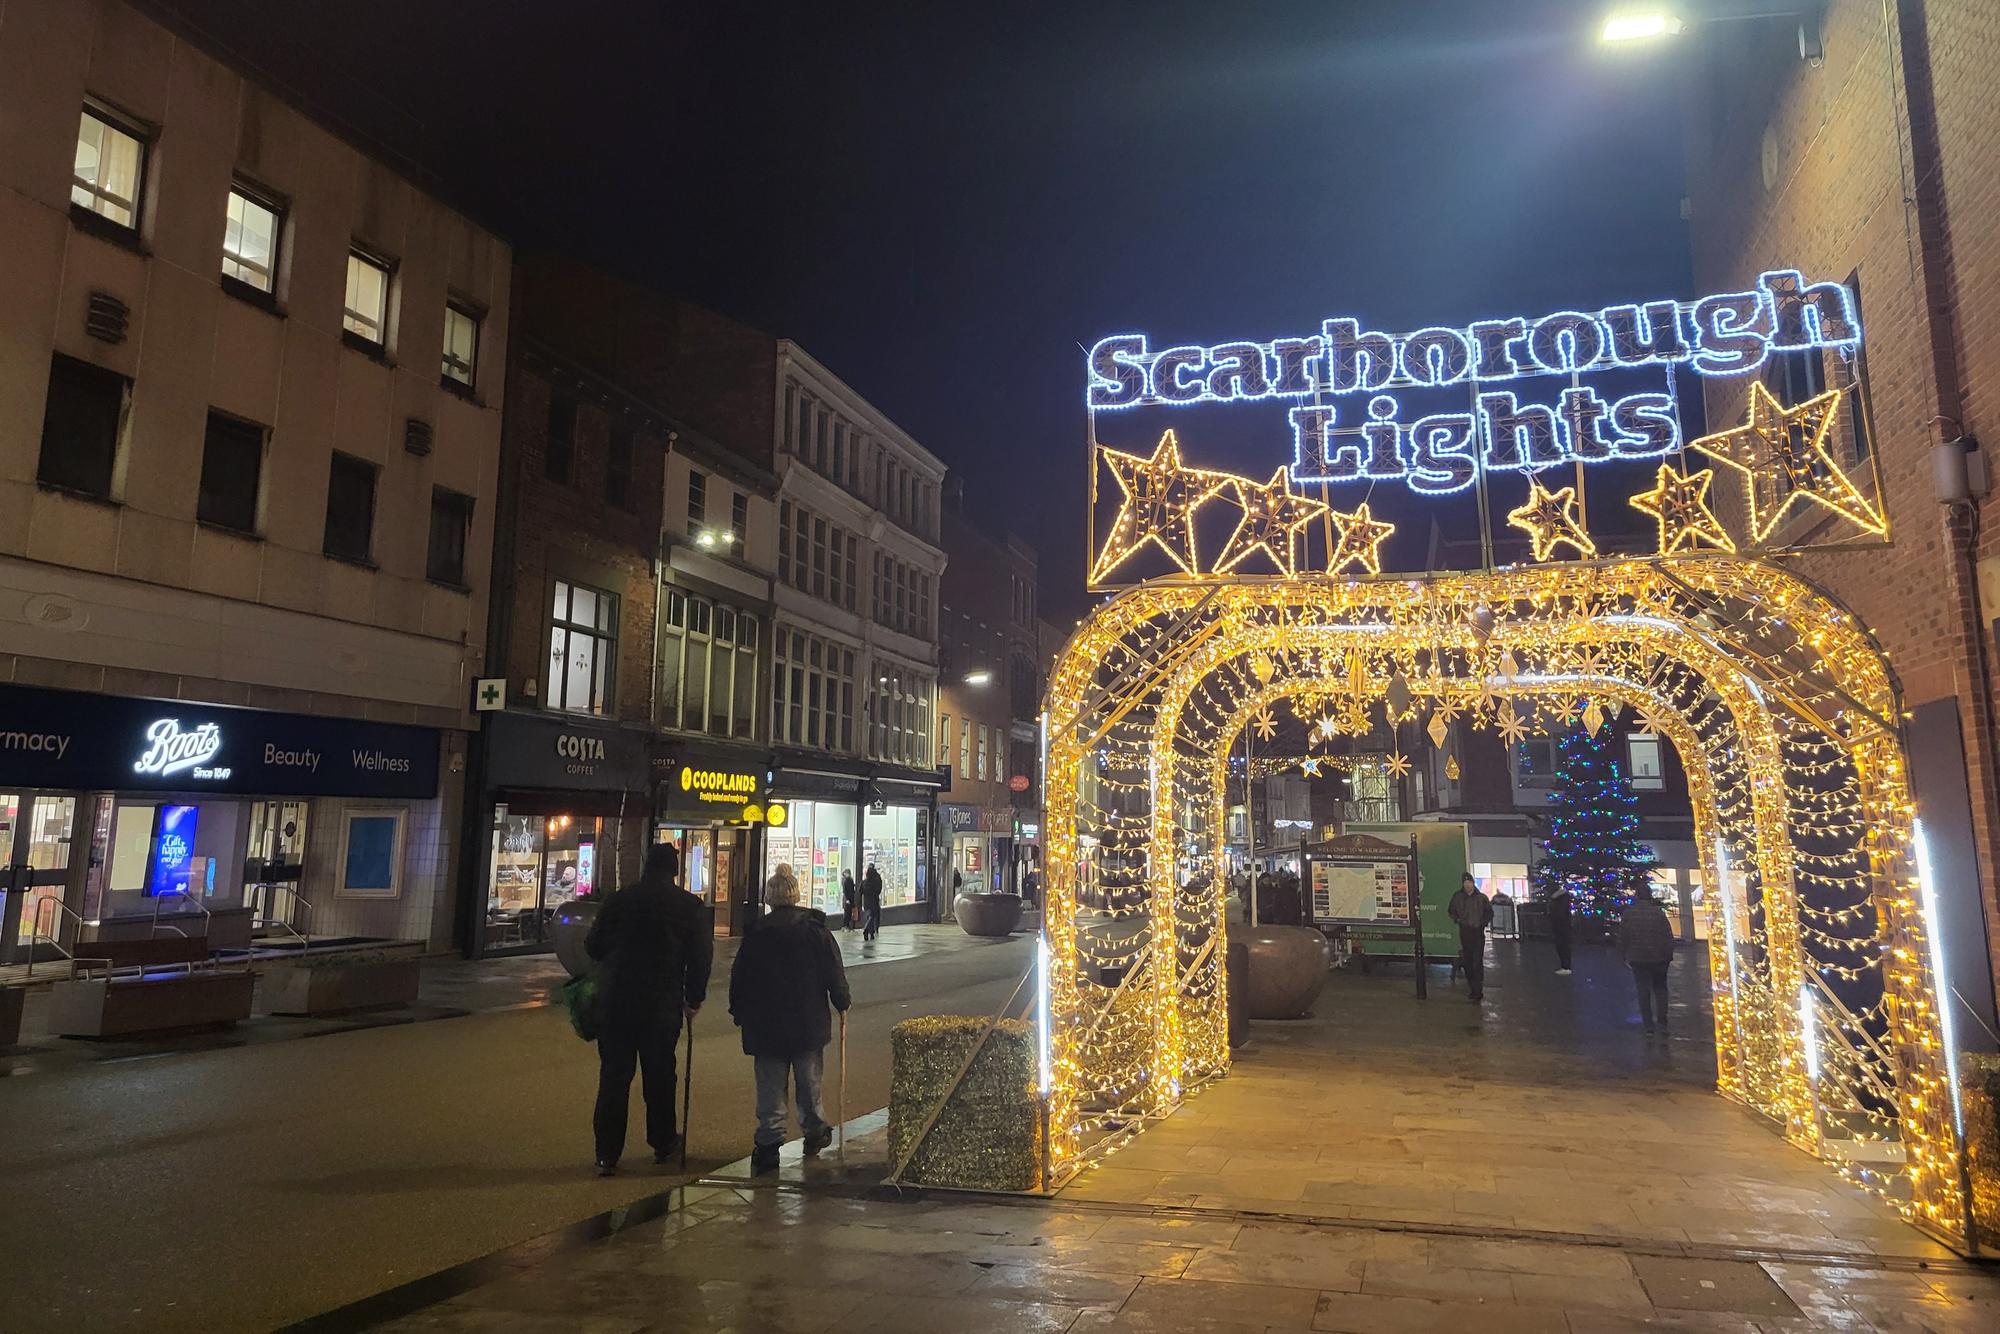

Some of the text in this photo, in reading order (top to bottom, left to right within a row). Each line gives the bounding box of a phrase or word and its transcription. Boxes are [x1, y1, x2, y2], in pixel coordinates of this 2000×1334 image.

[1086, 268, 1860, 410] Scarborough
[1288, 382, 1682, 495] Lights
[134, 718, 221, 777] Boots
[264, 743, 321, 773] Beauty
[352, 749, 410, 772] Wellness
[556, 734, 606, 762] COSTA
[566, 763, 594, 775] COFFEE
[692, 770, 757, 793] COOPLANDS
